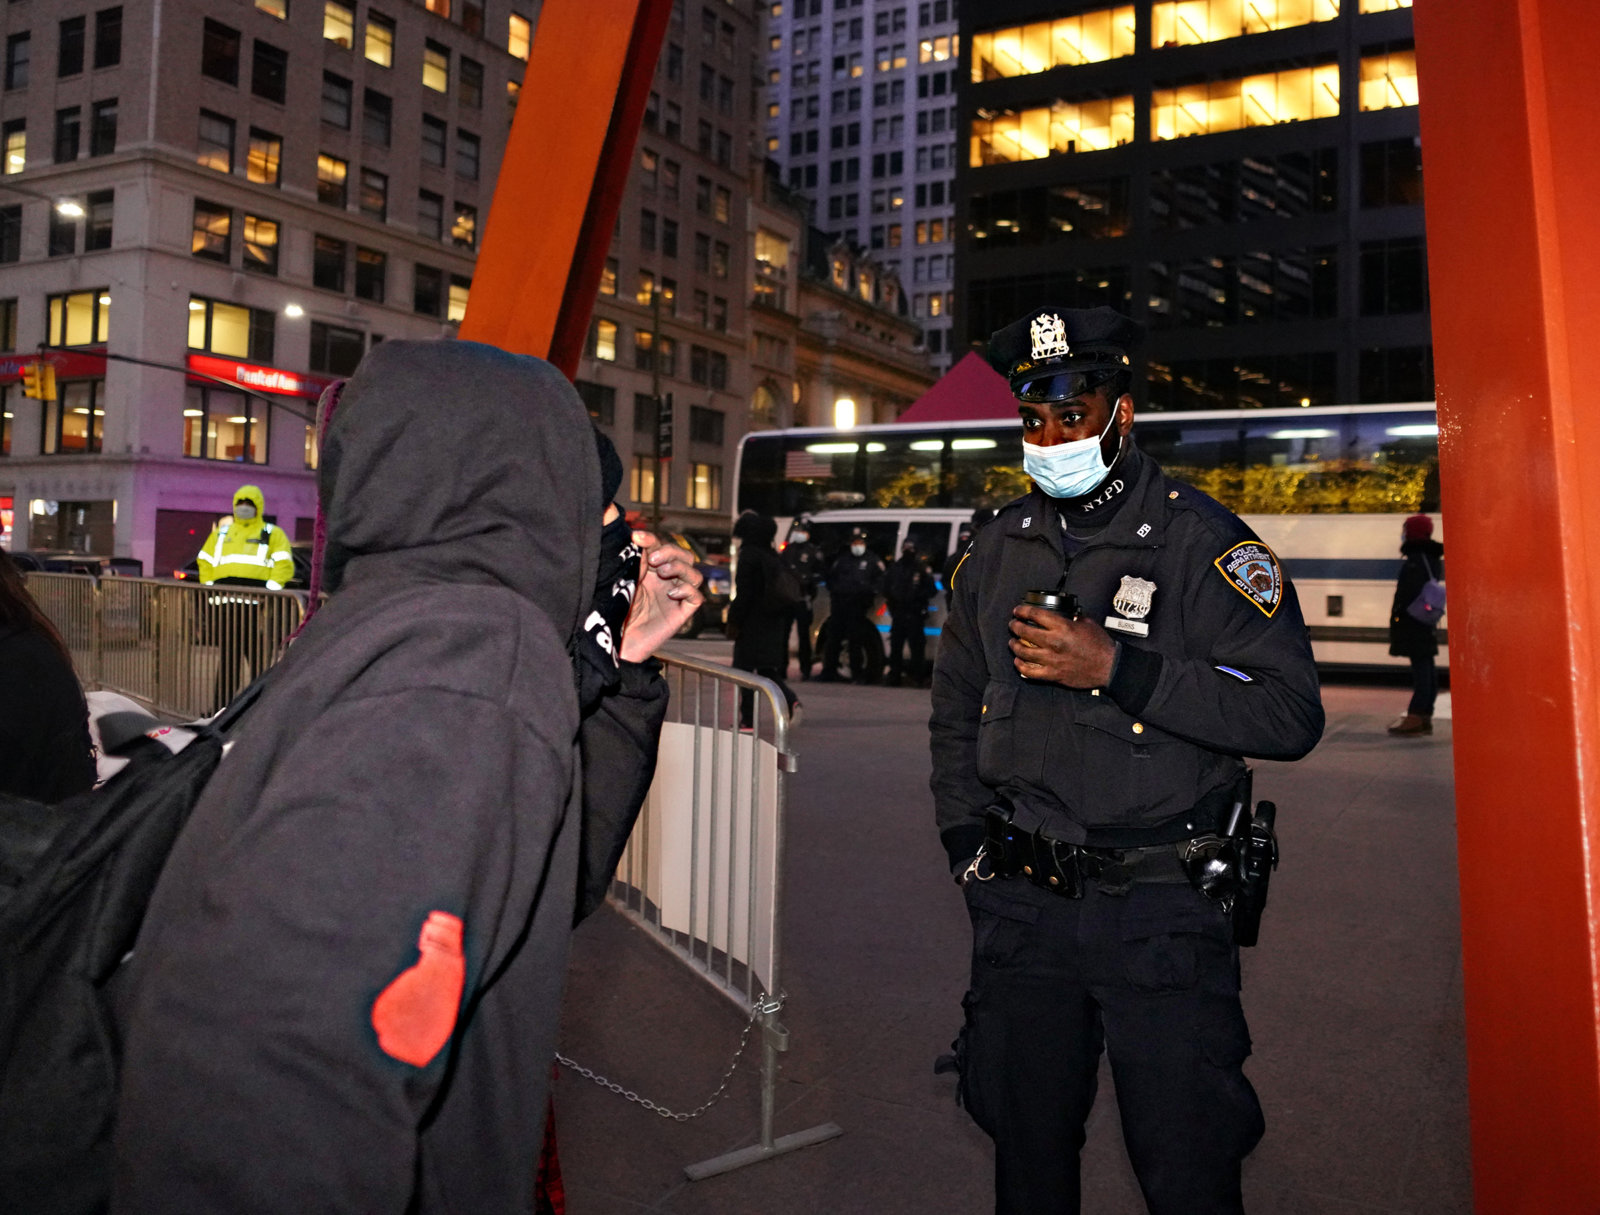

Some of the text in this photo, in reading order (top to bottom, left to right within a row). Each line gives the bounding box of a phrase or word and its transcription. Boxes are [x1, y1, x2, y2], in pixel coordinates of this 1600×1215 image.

[1081, 479, 1124, 512] NYPD
[1226, 552, 1271, 573] DEPARTMENT
[1231, 545, 1259, 560] POLICE
[1235, 579, 1265, 604] CITY OF
[1272, 588, 1280, 605] NEW
